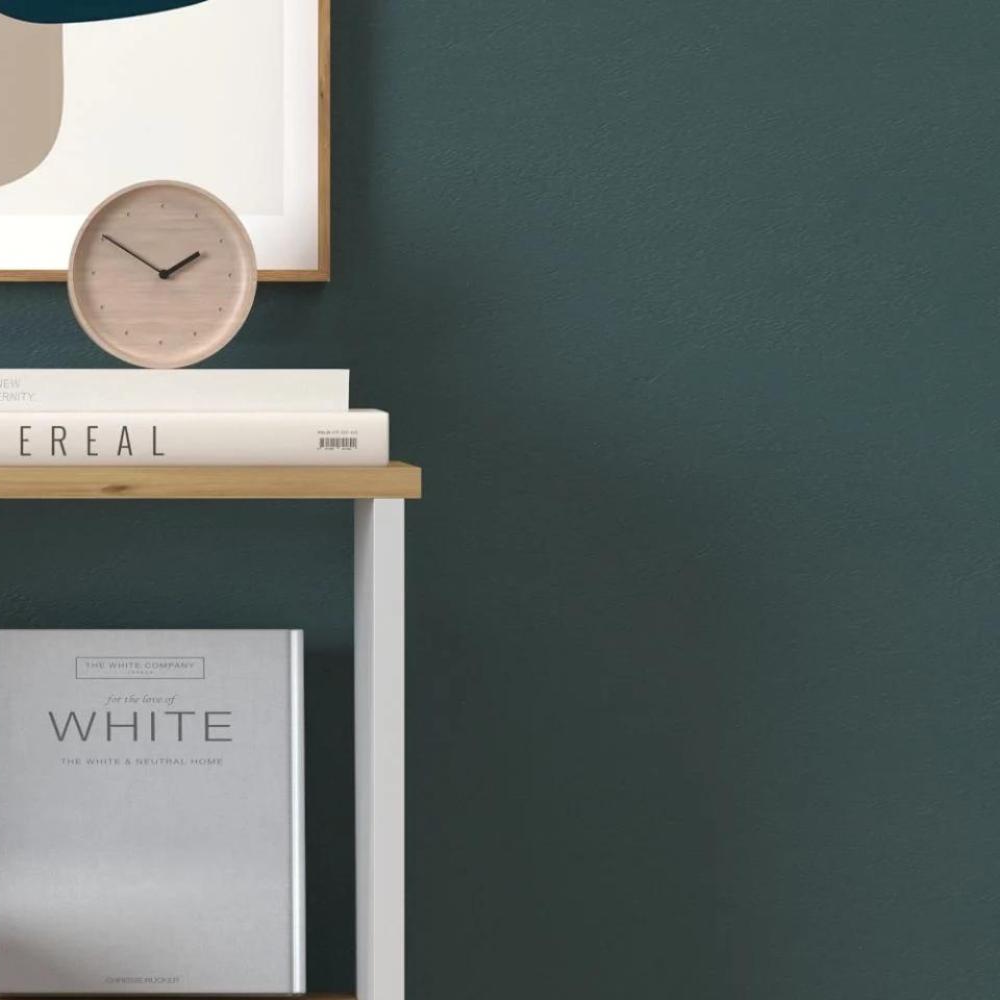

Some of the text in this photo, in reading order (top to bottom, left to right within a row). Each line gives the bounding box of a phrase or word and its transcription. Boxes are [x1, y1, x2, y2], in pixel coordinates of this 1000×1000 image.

[85, 661, 195, 669] THE WHITE COMPANY
[124, 694, 140, 704] the
[48, 711, 233, 742] WHITE
[61, 757, 224, 766] THE WHITE & NEUTRAL HOME
